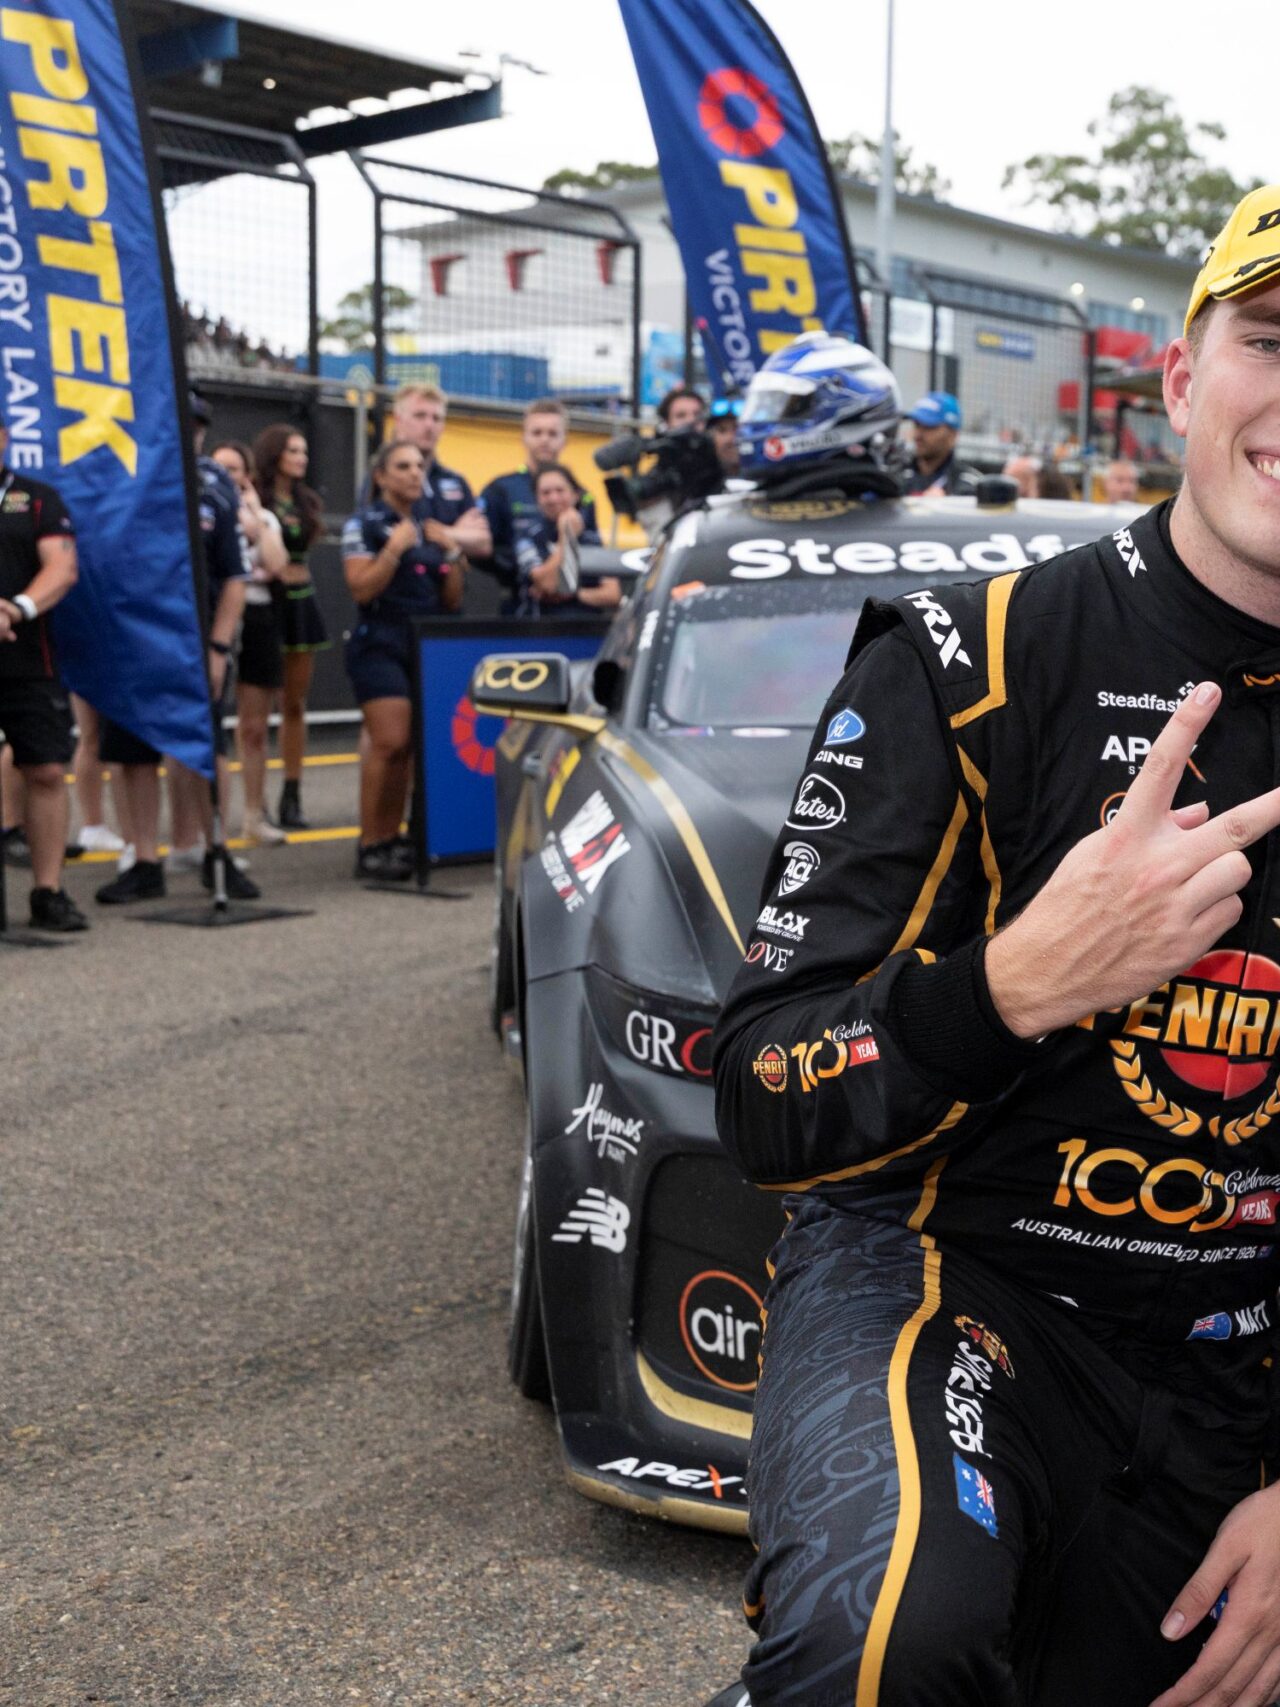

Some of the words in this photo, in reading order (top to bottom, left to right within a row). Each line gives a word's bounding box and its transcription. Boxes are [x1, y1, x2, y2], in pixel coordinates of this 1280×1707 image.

[1, 8, 137, 478] PIRTEK
[2, 347, 43, 470] LANE
[727, 533, 1085, 580] Steadf
[903, 590, 973, 669] HRX
[786, 860, 812, 883] ACL
[1240, 1198, 1272, 1221] YEARS
[1011, 1217, 1126, 1250] AUSTRALIAN
[1199, 1246, 1237, 1263] SINCE
[1237, 1246, 1257, 1261] 1926
[692, 1304, 759, 1361] air
[1236, 1300, 1271, 1336] MATT
[597, 1456, 743, 1500] APEX
